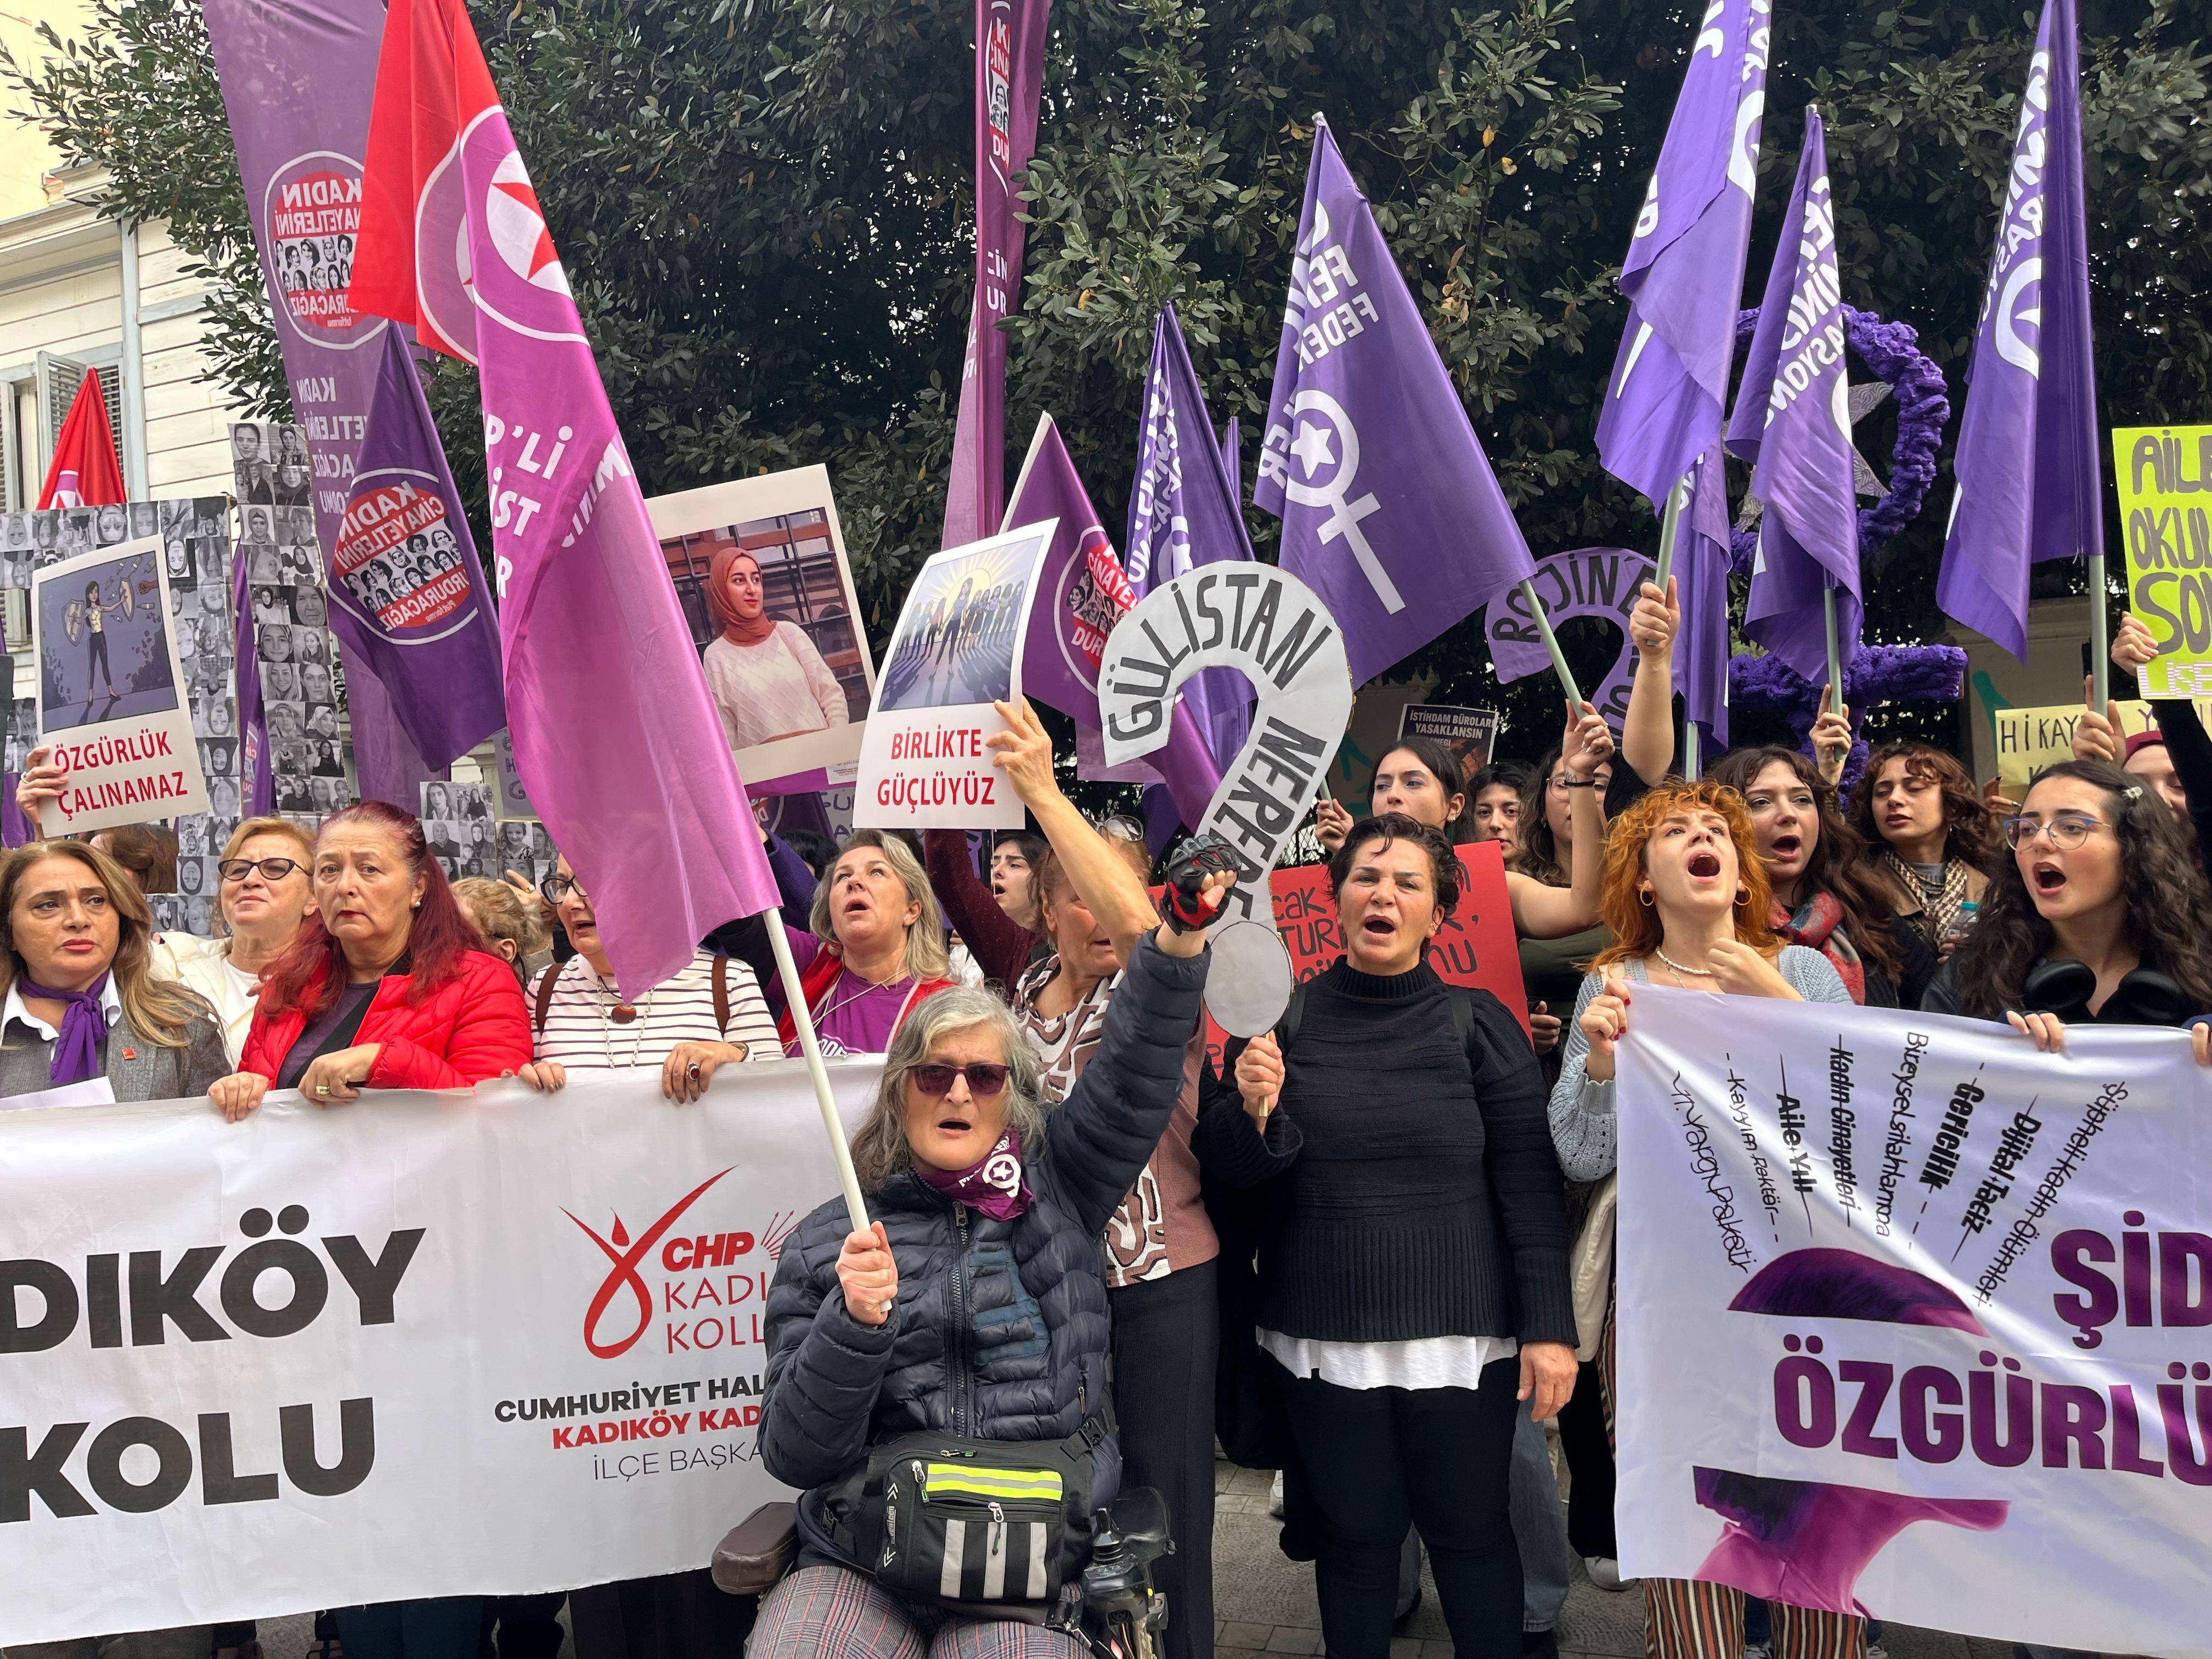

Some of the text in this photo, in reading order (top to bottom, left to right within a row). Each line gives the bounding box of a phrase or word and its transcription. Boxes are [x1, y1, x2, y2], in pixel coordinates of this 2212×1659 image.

[1107, 574, 1332, 742] GÜLİSTAN
[890, 724, 981, 760] BİRLİKTE
[1409, 709, 1494, 729] İSTİHDAM BÜROLARI
[1415, 723, 1483, 740] YASAKLANSIN
[54, 728, 172, 774] ÖZGÜRLÜK
[58, 771, 188, 821] ÇALINAMAZ
[877, 770, 995, 814] GÜÇLÜYÜZ
[1776, 1093, 1807, 1146] Aile
[1827, 1047, 1863, 1211] Kadın Cinayetleri
[1918, 1082, 1985, 1190] Gericilik
[2064, 1082, 2129, 1162] Şüpheli
[1751, 1154, 1781, 1215] Rektör
[1961, 1111, 2042, 1234] Dijital Taciz
[2025, 1158, 2078, 1218] Kadın
[662, 1231, 755, 1272] CHP
[1705, 1186, 1757, 1272] Paketi
[0, 1204, 427, 1354] DIKÖY
[665, 1272, 766, 1313] KADI
[2051, 1210, 2212, 1349] ŞİD
[667, 1313, 765, 1354] KOLL
[494, 1374, 765, 1422] CUMHURİYET HAL
[1774, 1334, 2212, 1486] ÖZGÜRLÜ
[552, 1404, 760, 1449] KADIKÖY KAD
[0, 1396, 375, 1523] KOLU
[594, 1452, 659, 1482] İLÇE
